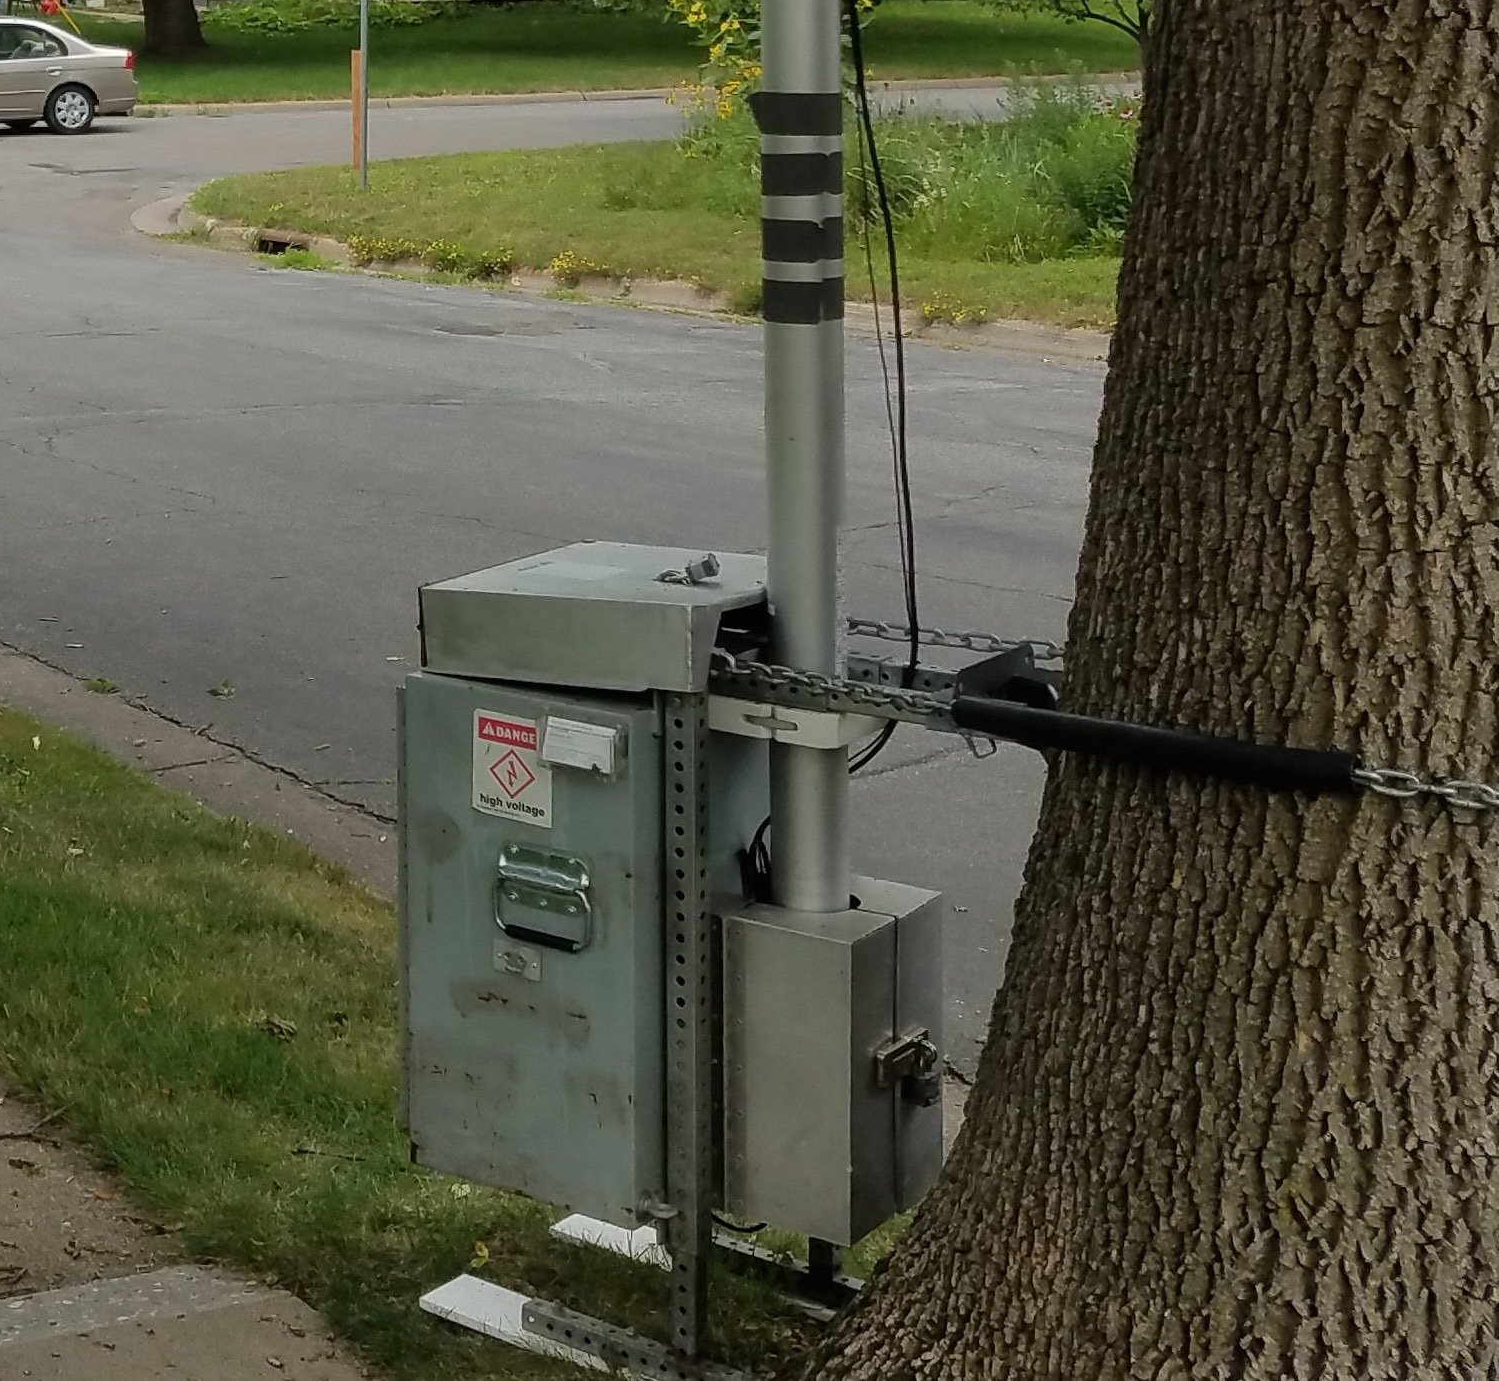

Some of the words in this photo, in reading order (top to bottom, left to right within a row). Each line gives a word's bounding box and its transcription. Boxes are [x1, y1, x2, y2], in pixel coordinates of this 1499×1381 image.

[495, 725, 536, 745] DANGE
[479, 793, 503, 808] high
[505, 801, 546, 817] voltage
